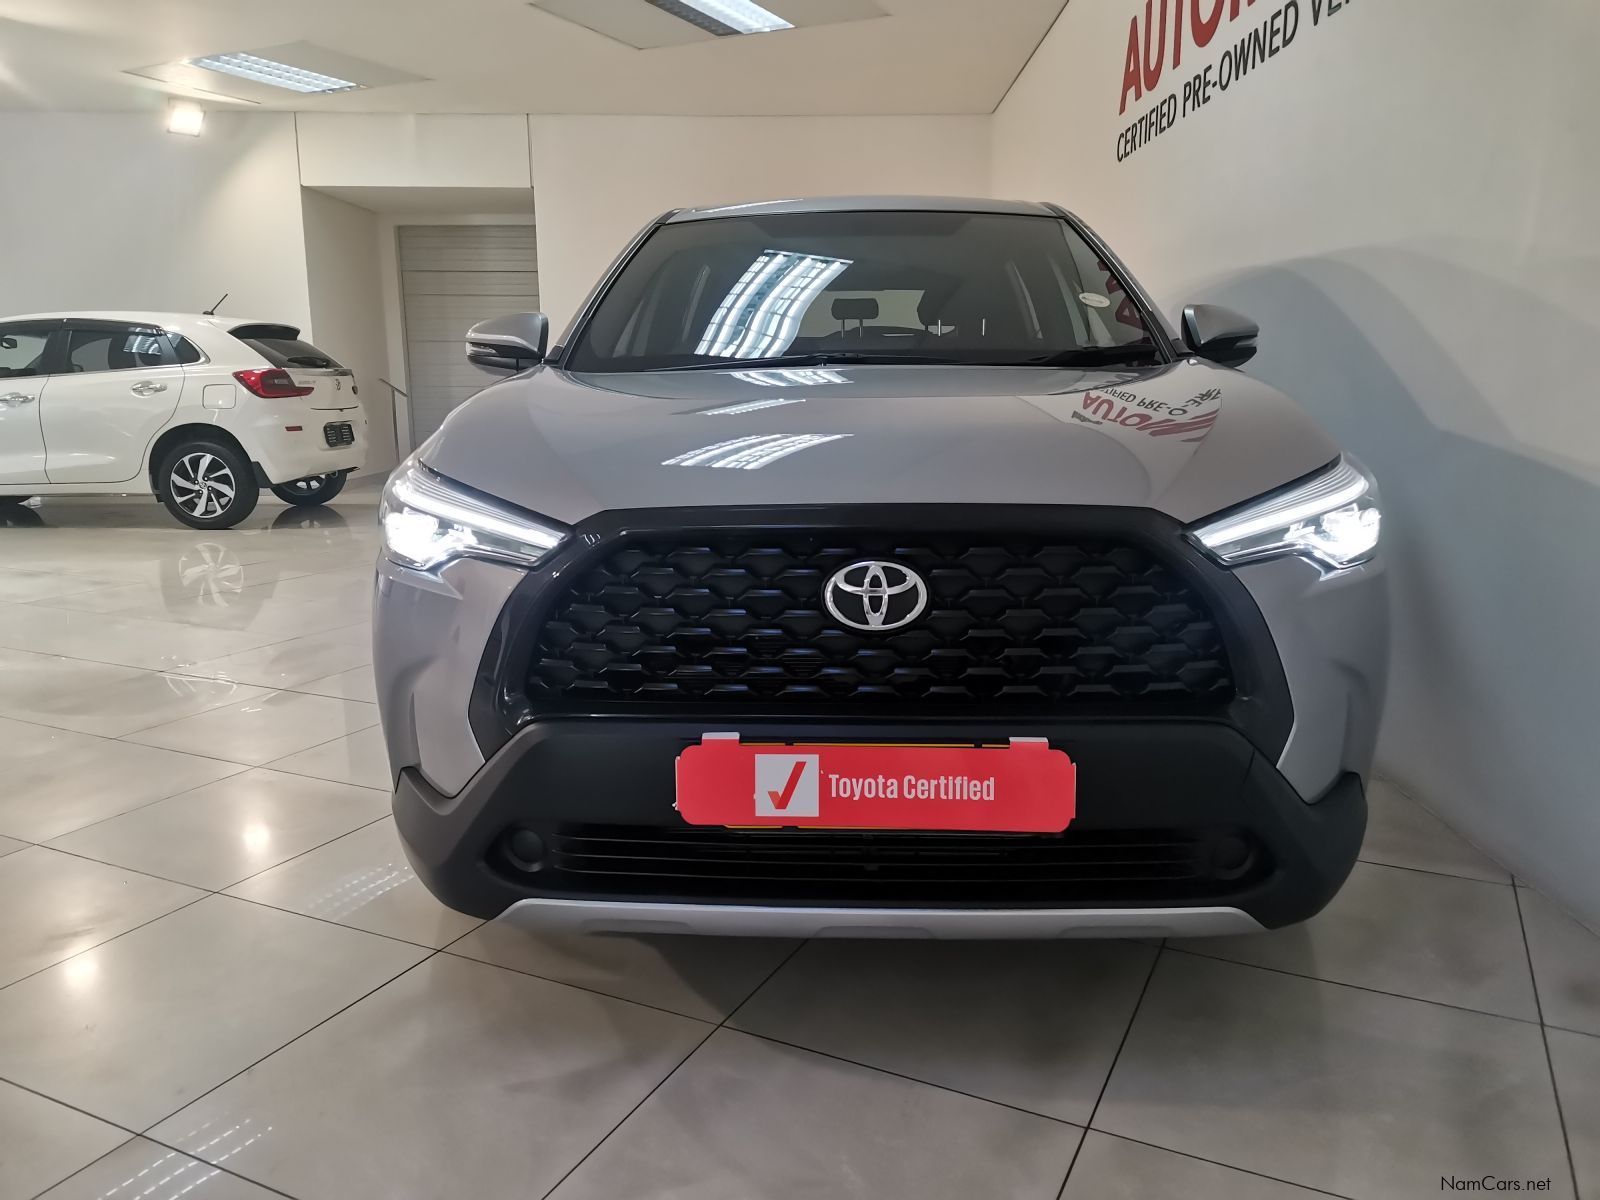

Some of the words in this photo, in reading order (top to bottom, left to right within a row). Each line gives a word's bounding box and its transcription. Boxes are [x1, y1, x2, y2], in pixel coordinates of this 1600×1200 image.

[1116, 93, 1177, 163] CERTIFIED
[1182, 0, 1299, 118] PRE-OWNED
[829, 774, 898, 800] Toyota
[904, 775, 995, 801] Certified
